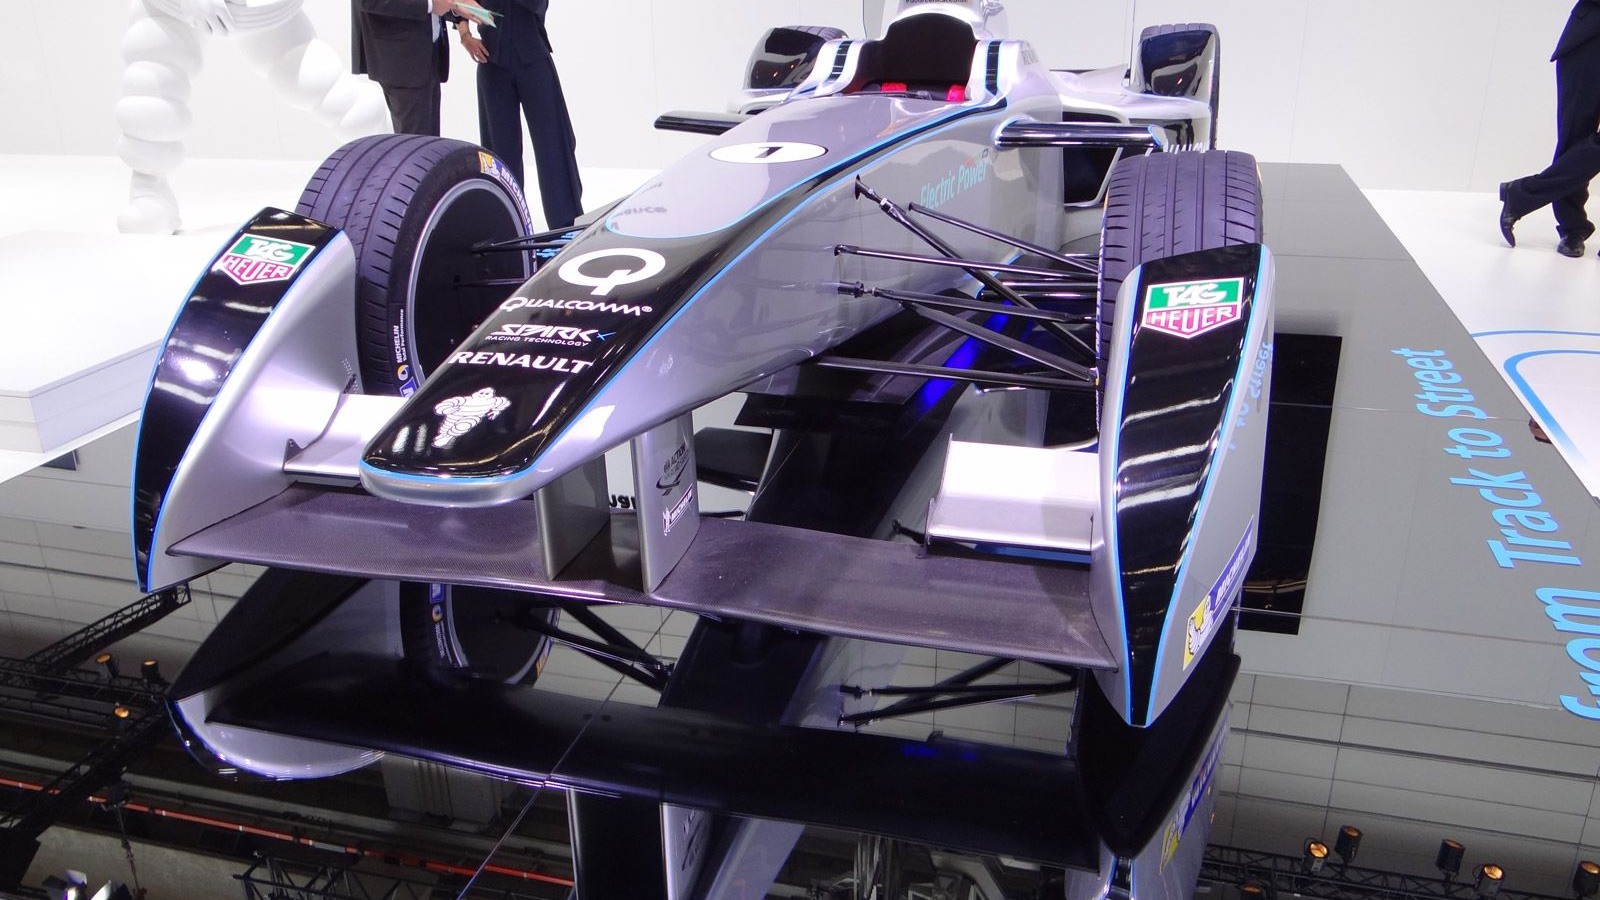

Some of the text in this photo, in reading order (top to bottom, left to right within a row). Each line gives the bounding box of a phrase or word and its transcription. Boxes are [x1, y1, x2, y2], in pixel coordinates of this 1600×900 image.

[920, 160, 987, 210] Electric Power
[244, 238, 295, 262] TAG
[222, 254, 287, 281] HEUER
[1163, 283, 1227, 307] TAG
[490, 323, 600, 342] SPARK
[1150, 306, 1233, 333] HEUER
[393, 325, 403, 363] MICHELIN
[524, 336, 589, 347] TECHNOLOGY
[448, 351, 594, 375] RENAULT
[1390, 348, 1488, 420] Street
[1444, 427, 1512, 459] to
[1449, 467, 1583, 569] Track
